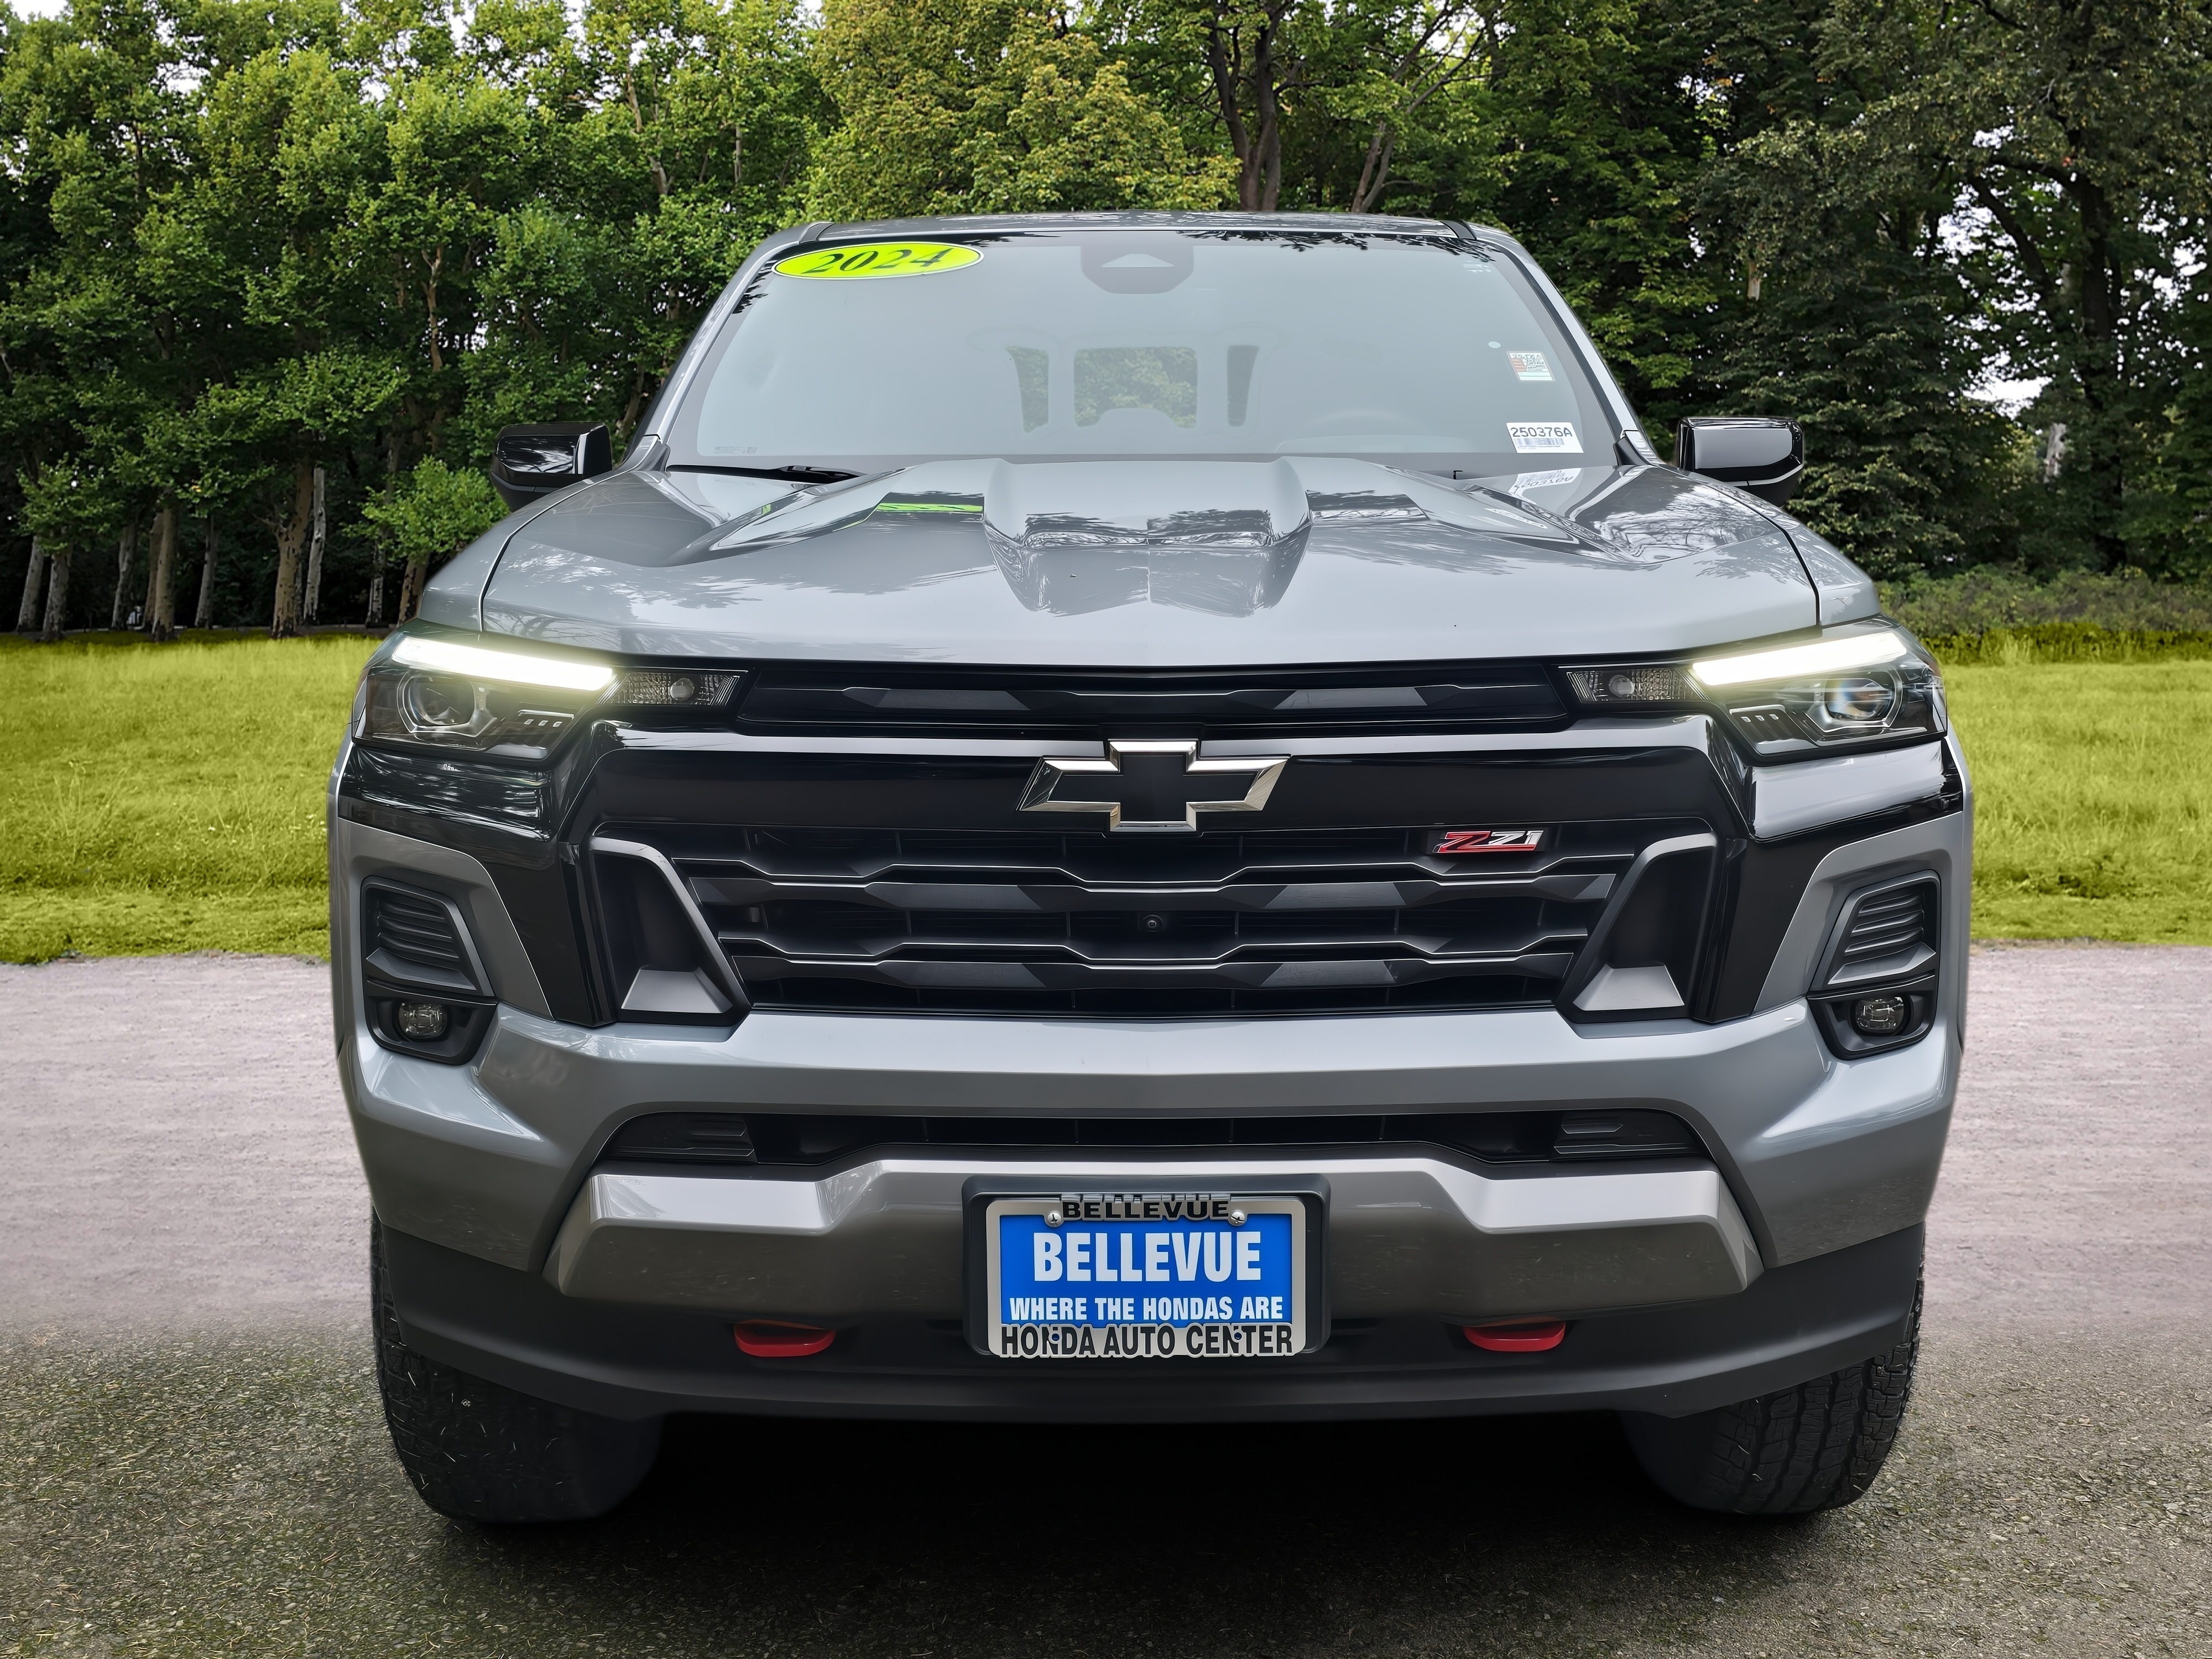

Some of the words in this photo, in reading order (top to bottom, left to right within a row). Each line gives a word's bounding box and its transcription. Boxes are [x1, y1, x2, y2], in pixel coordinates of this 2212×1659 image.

[801, 247, 954, 274] 2024
[1510, 427, 1573, 437] 250376A
[1437, 830, 1544, 853] Z71
[1062, 1200, 1229, 1219] BELLEVUE
[1033, 1231, 1262, 1282] BELLEVUE
[1009, 1297, 1087, 1321] WHERE
[1094, 1297, 1135, 1321] THE
[1143, 1296, 1233, 1321] HONDAS
[1240, 1296, 1284, 1319] ARE
[1001, 1326, 1095, 1355] HONDA
[1103, 1326, 1176, 1355] AUTO
[1186, 1325, 1292, 1355] CENTER
